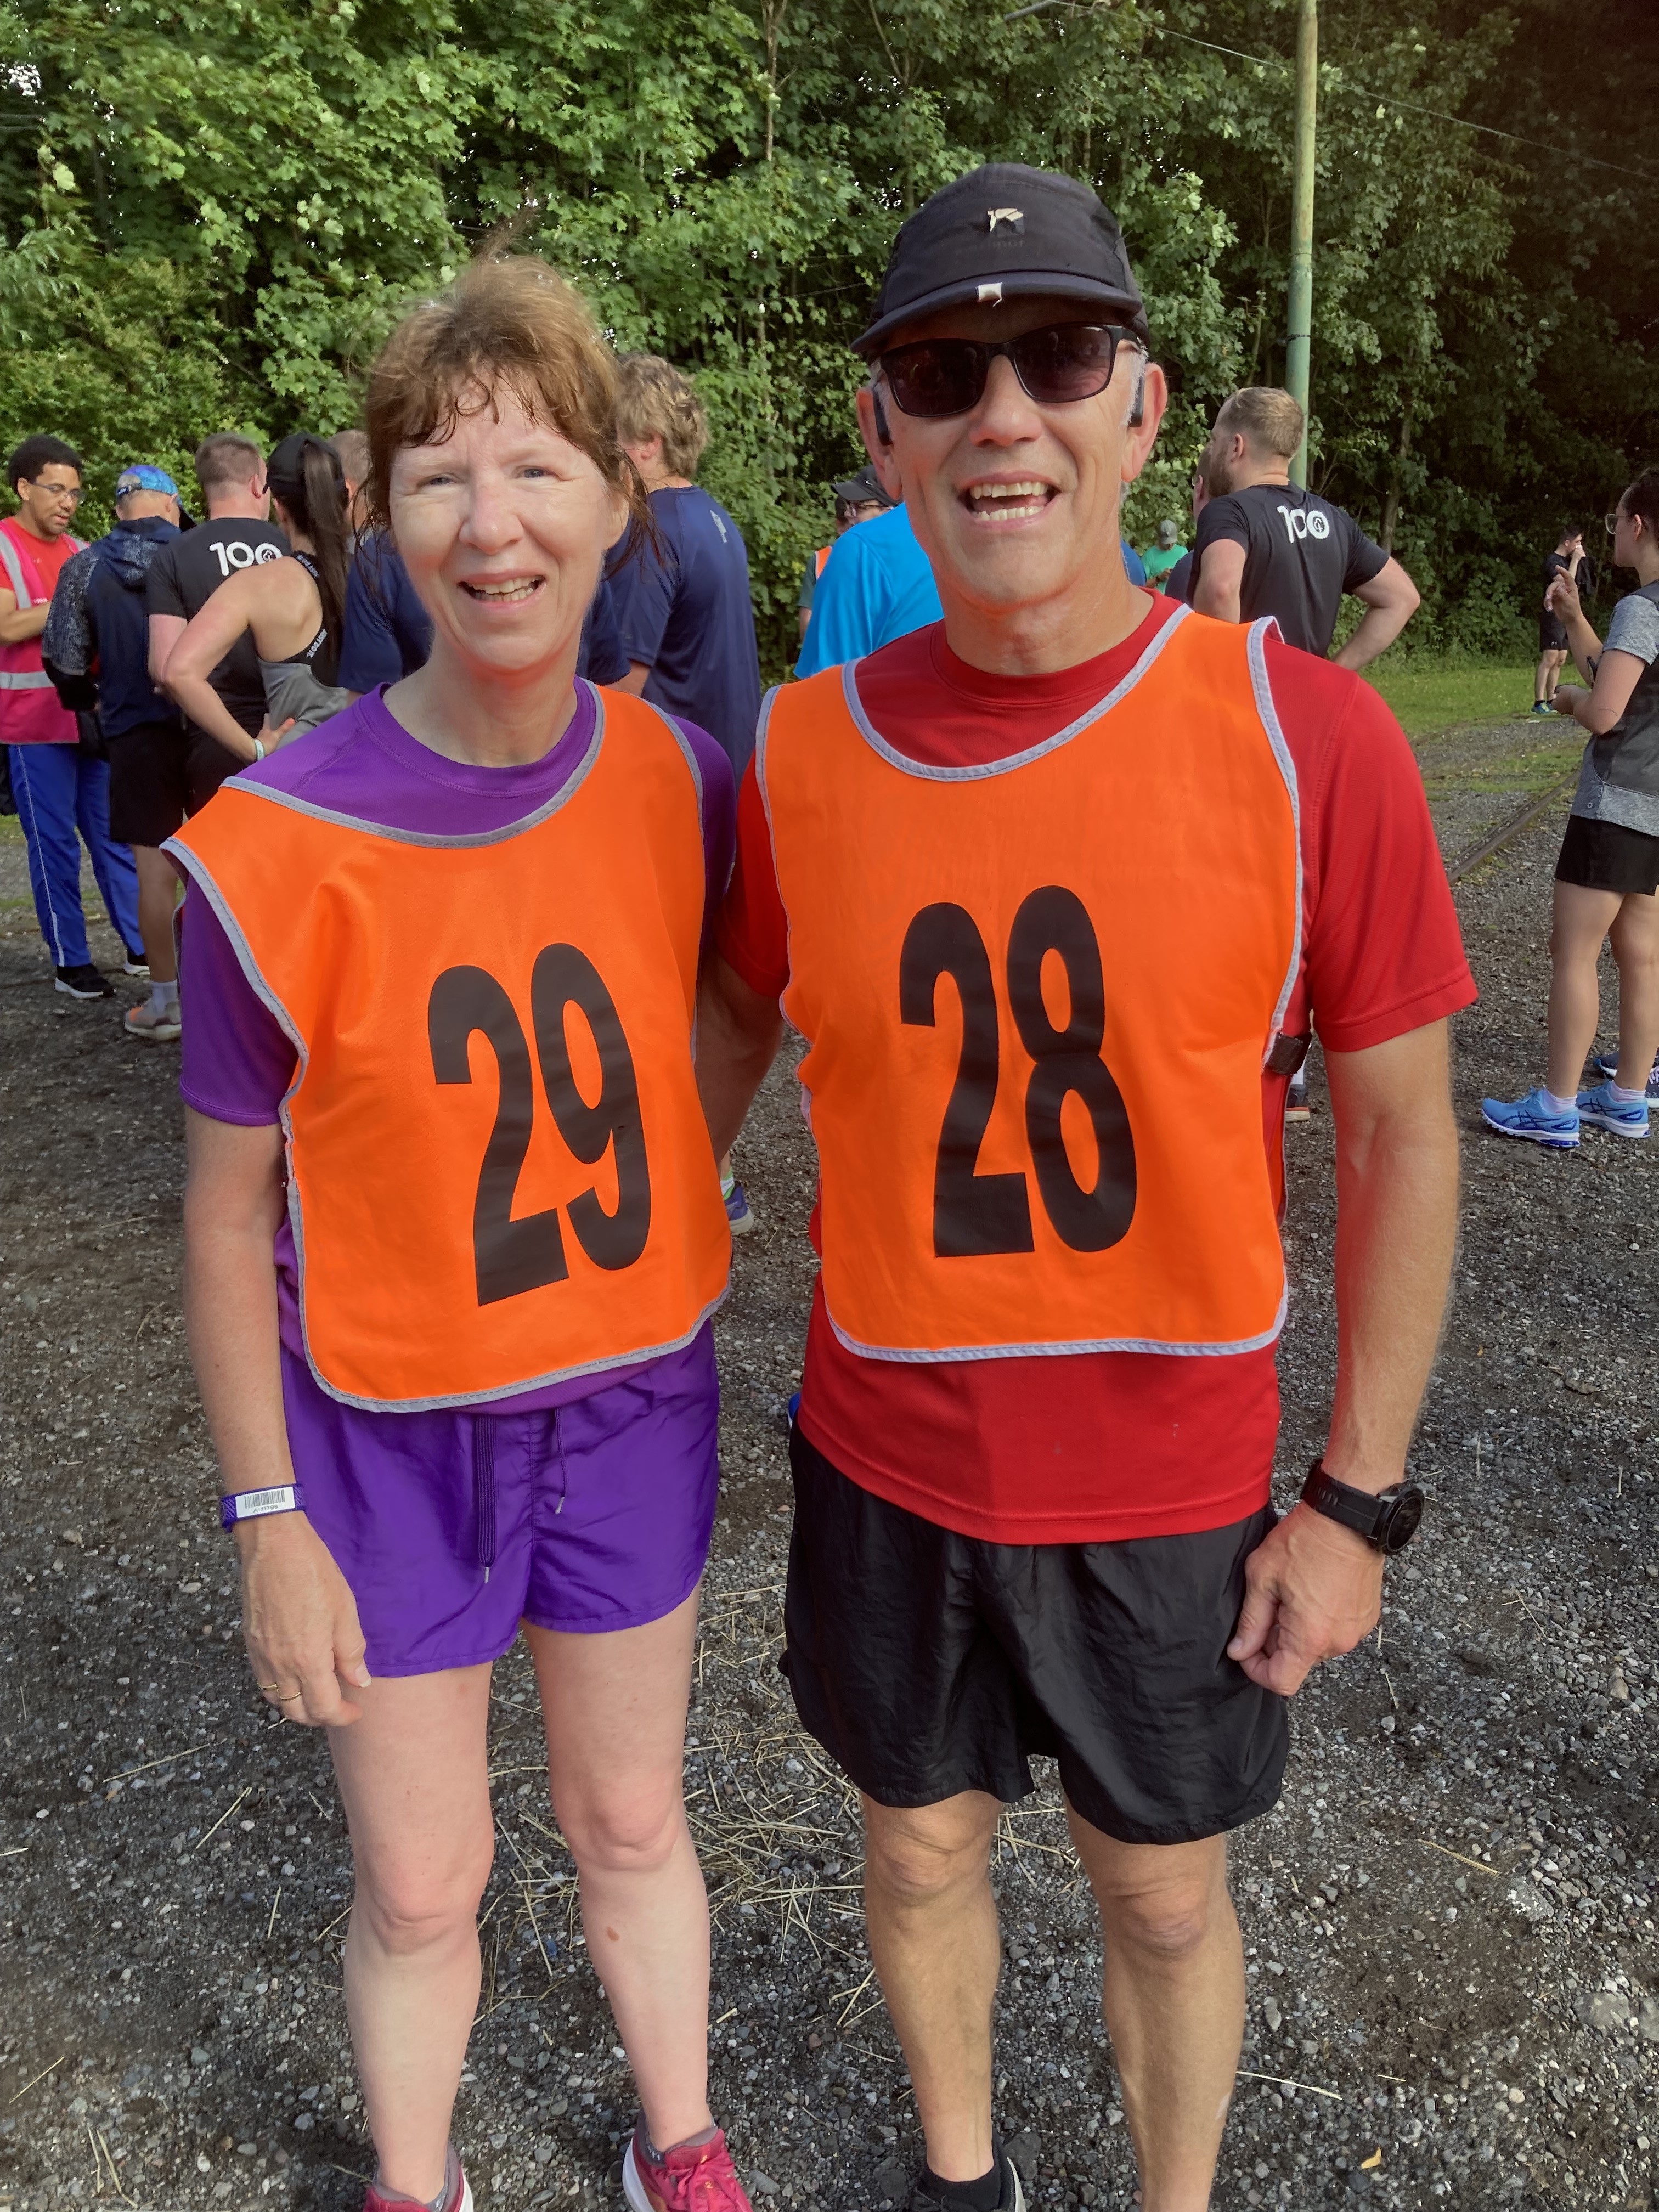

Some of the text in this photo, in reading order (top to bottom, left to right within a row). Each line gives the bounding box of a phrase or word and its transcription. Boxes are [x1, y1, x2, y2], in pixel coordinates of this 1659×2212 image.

[1277, 505, 1330, 544] 100
[311, 641, 320, 652] DO
[317, 629, 328, 644] JUST
[899, 885, 1137, 1257] 28
[428, 943, 651, 1307] 29
[253, 1504, 278, 1513] A171798
